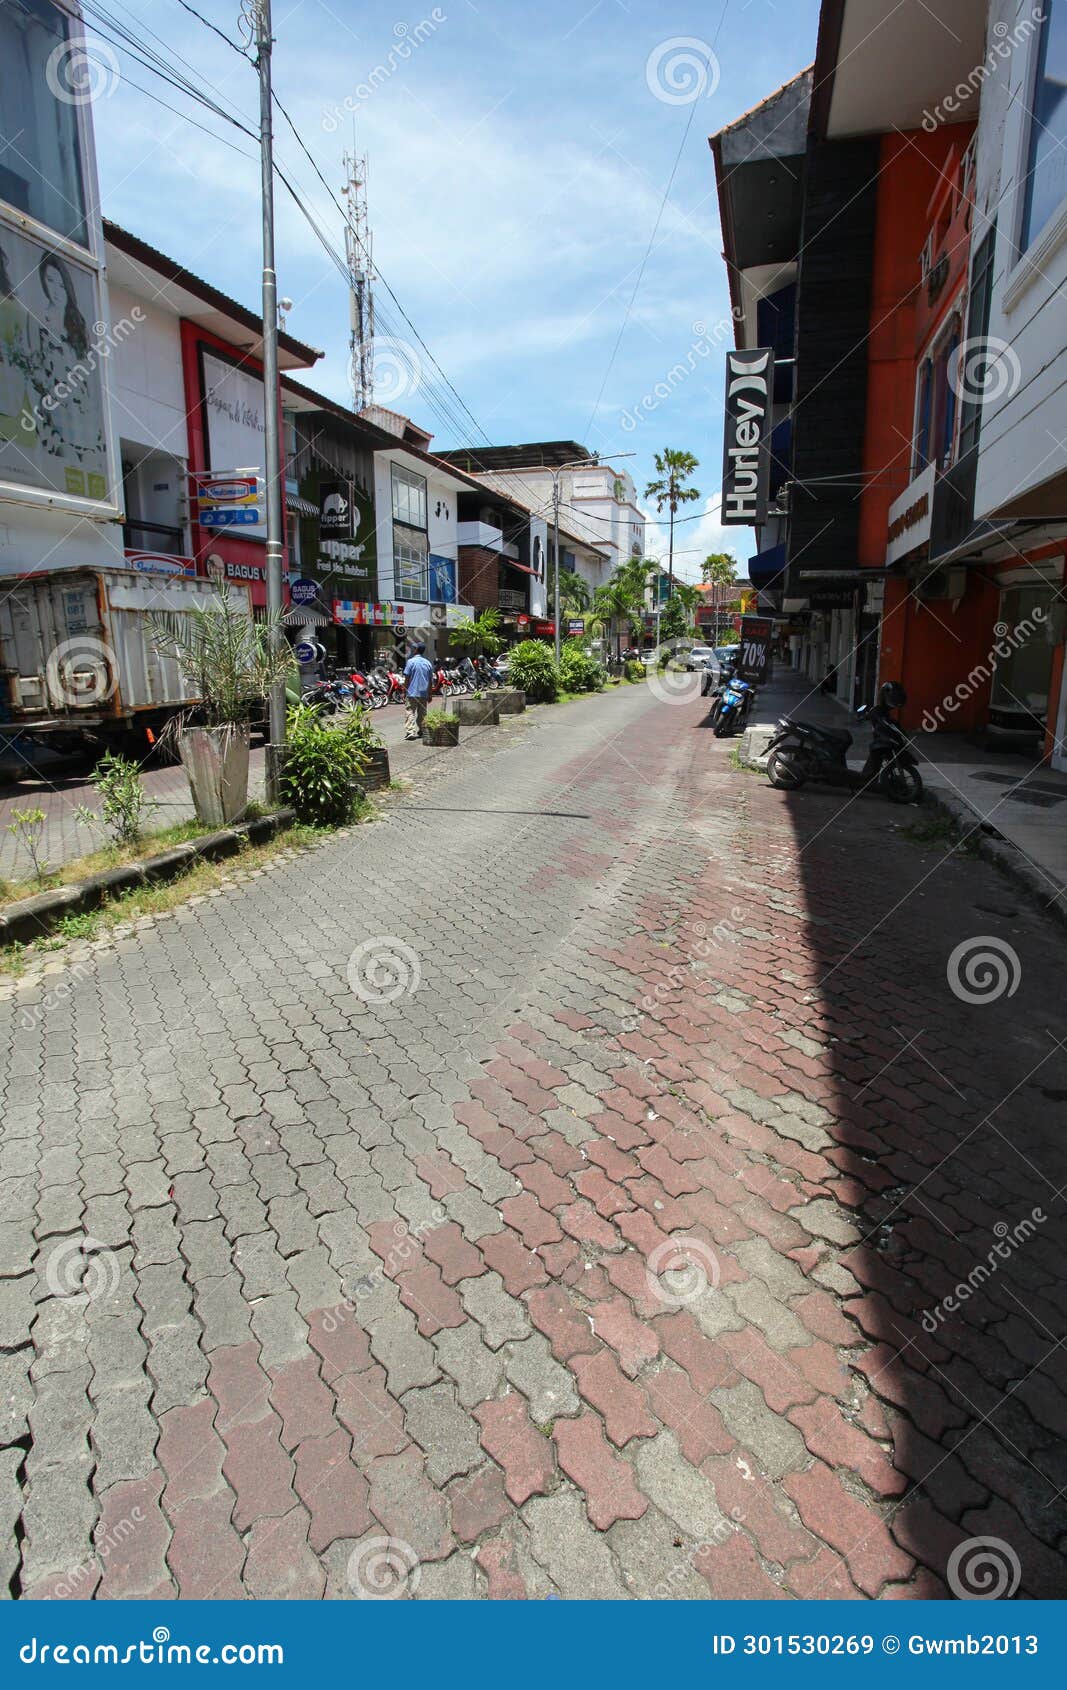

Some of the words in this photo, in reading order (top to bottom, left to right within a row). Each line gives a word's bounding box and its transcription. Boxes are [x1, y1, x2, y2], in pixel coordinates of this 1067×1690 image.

[726, 398, 765, 518] Hurley
[227, 563, 259, 580] BAGUS
[742, 642, 766, 667] 70%
